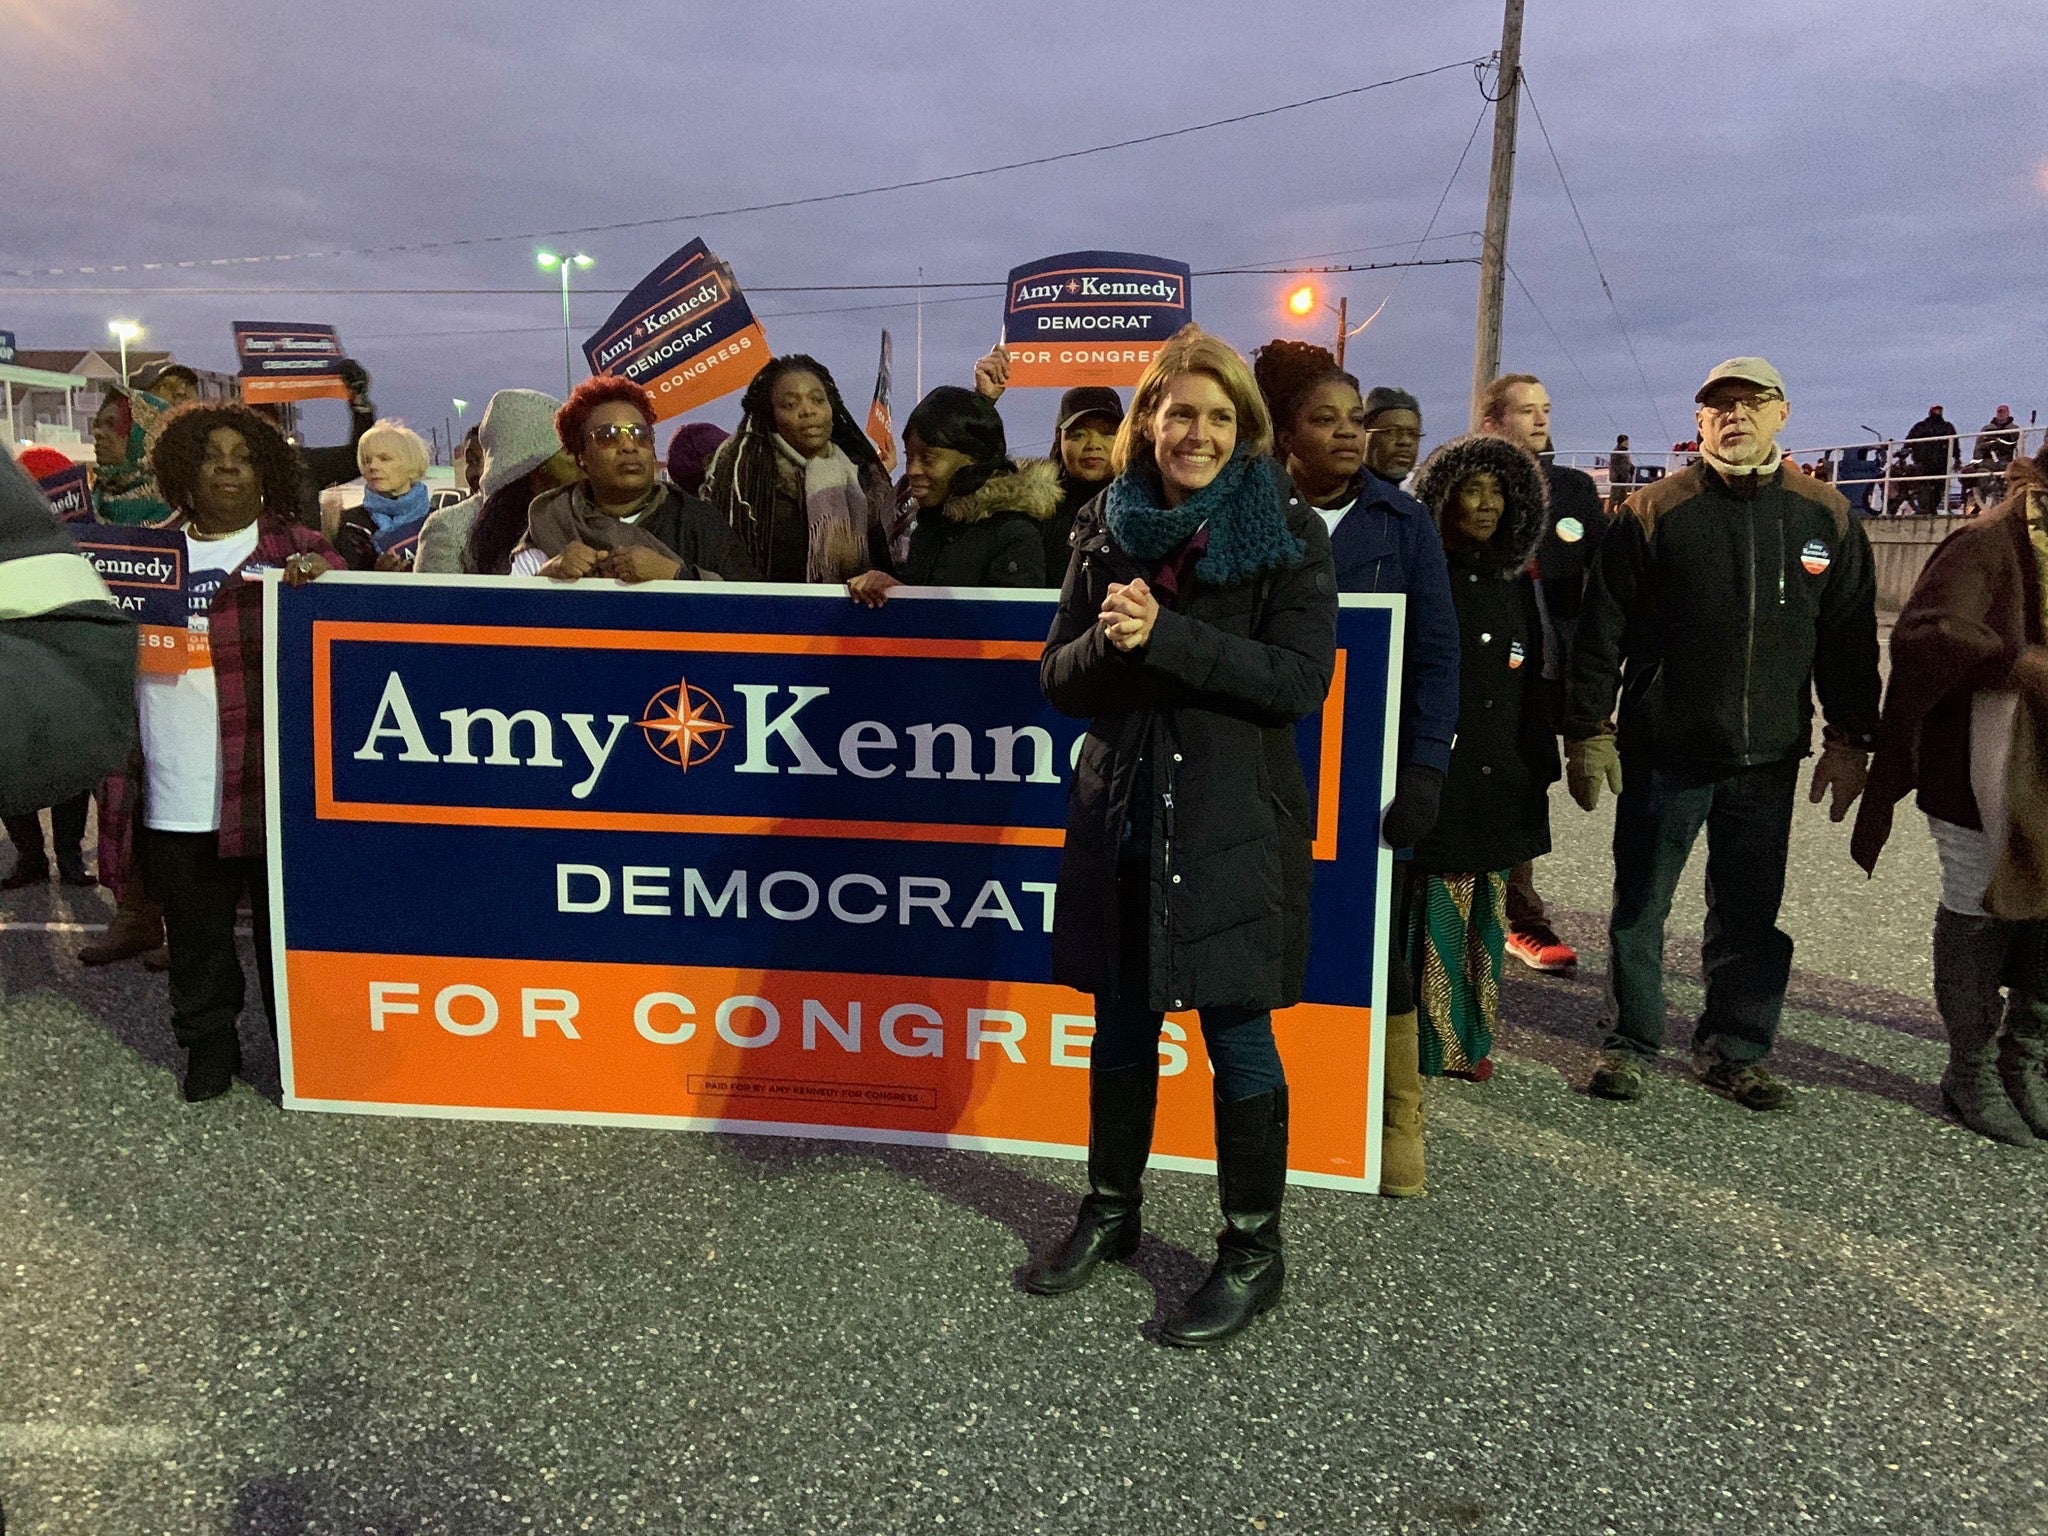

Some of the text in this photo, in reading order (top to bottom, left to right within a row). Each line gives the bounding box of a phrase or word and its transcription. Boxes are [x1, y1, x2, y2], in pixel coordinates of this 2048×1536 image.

[1017, 277, 1177, 302] Amy Kennedy
[600, 284, 718, 366] Amy Kennedy
[1037, 315, 1152, 330] DEMOCRAT
[625, 321, 714, 378] DEMOCRAT
[659, 336, 752, 393] CONGRESS
[1009, 350, 1051, 363] FOR
[50, 490, 81, 516] nedy
[80, 552, 173, 583] ennedy
[353, 671, 1088, 799] Amy Kenn
[556, 863, 1058, 933] DEMOCRAT
[368, 981, 1216, 1077] FOR CONGRES
[768, 1085, 791, 1094] AMY
[842, 1090, 862, 1098] FOR
[865, 1091, 918, 1102] CONGRESS
